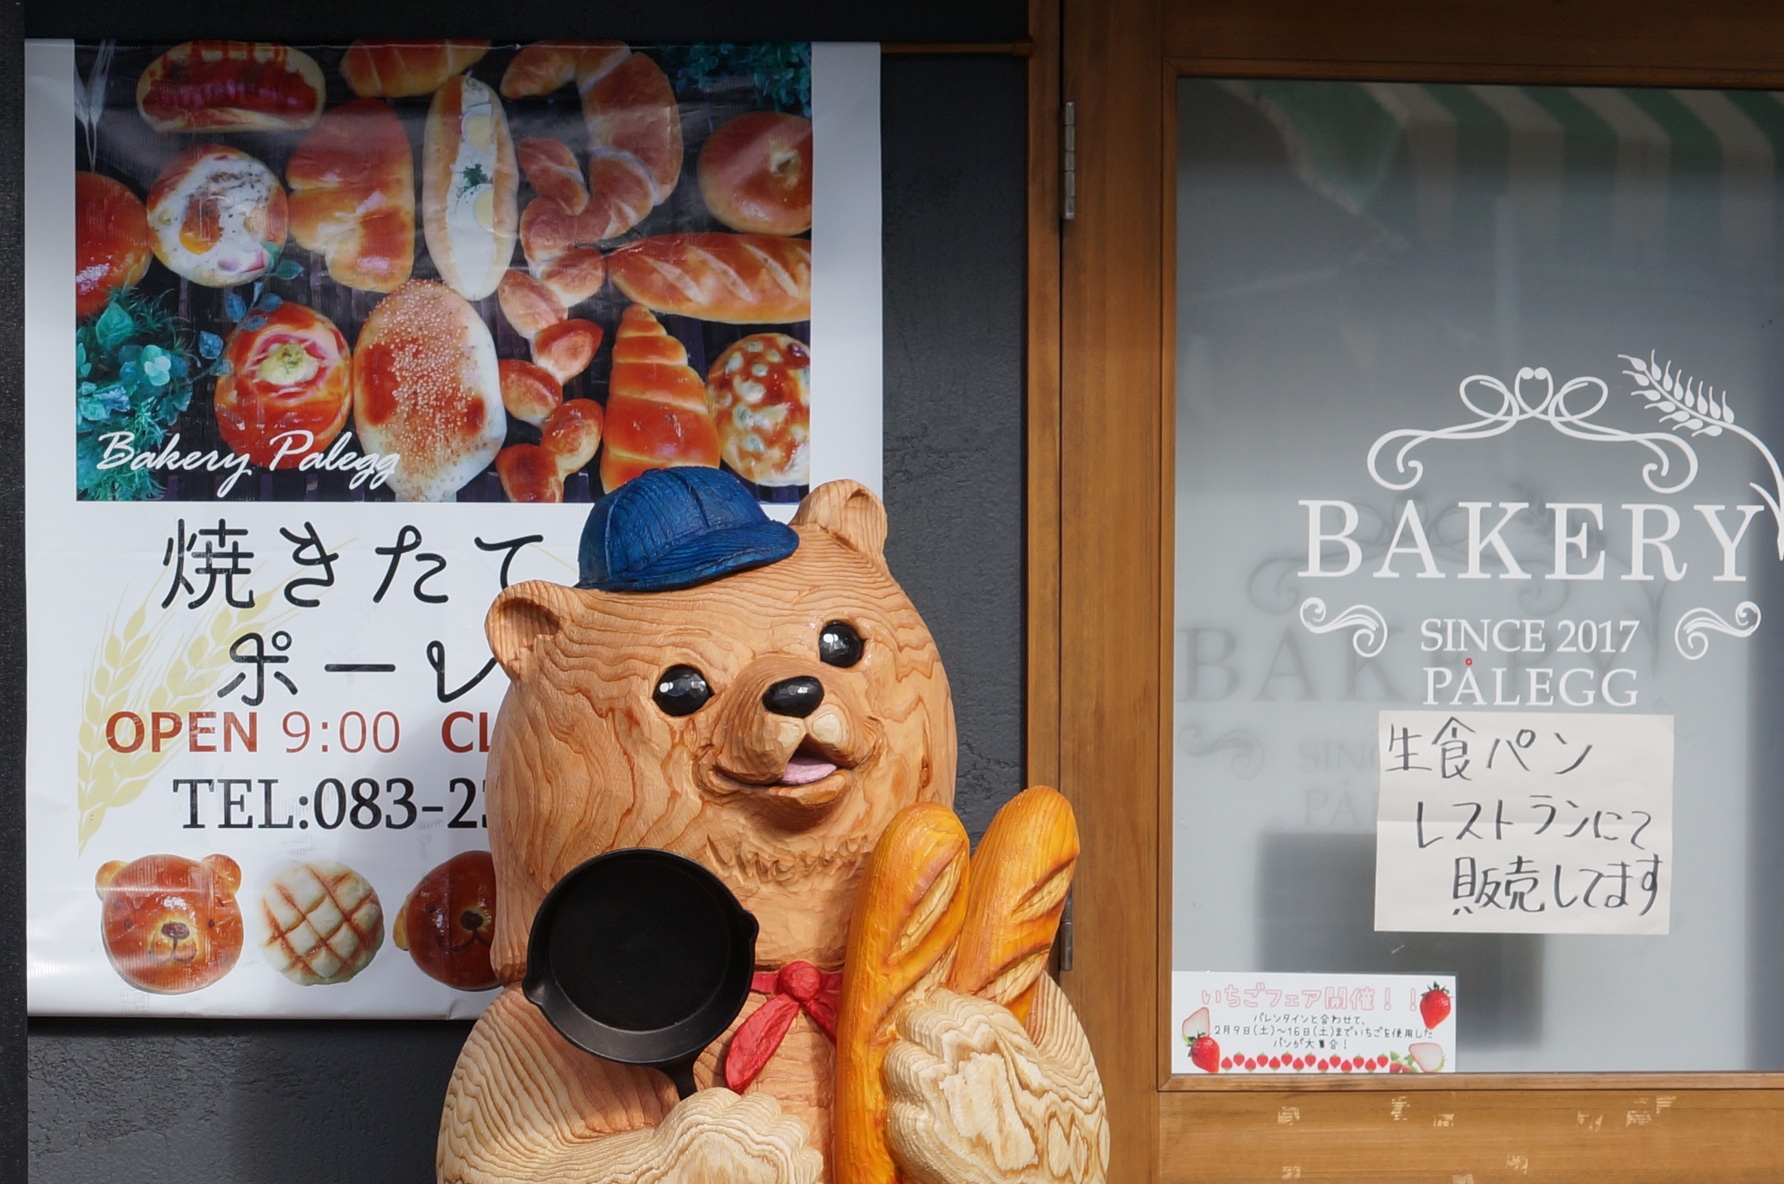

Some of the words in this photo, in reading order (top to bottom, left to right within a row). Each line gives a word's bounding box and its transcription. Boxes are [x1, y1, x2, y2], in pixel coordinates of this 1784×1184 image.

[96, 432, 253, 497] Bakery
[269, 430, 401, 490] Palegg
[161, 518, 545, 610] 焼きたて
[1297, 498, 1765, 583] BAKERY
[1420, 618, 1546, 653] SINCE
[1556, 618, 1640, 653] 2017
[105, 711, 258, 754] OPEN
[282, 710, 401, 754] 9:00
[1386, 716, 1593, 781] 生食パン
[173, 777, 487, 830] TEL:083-2
[1416, 794, 1652, 850] レストランにて
[1452, 852, 1663, 917] 販売してます
